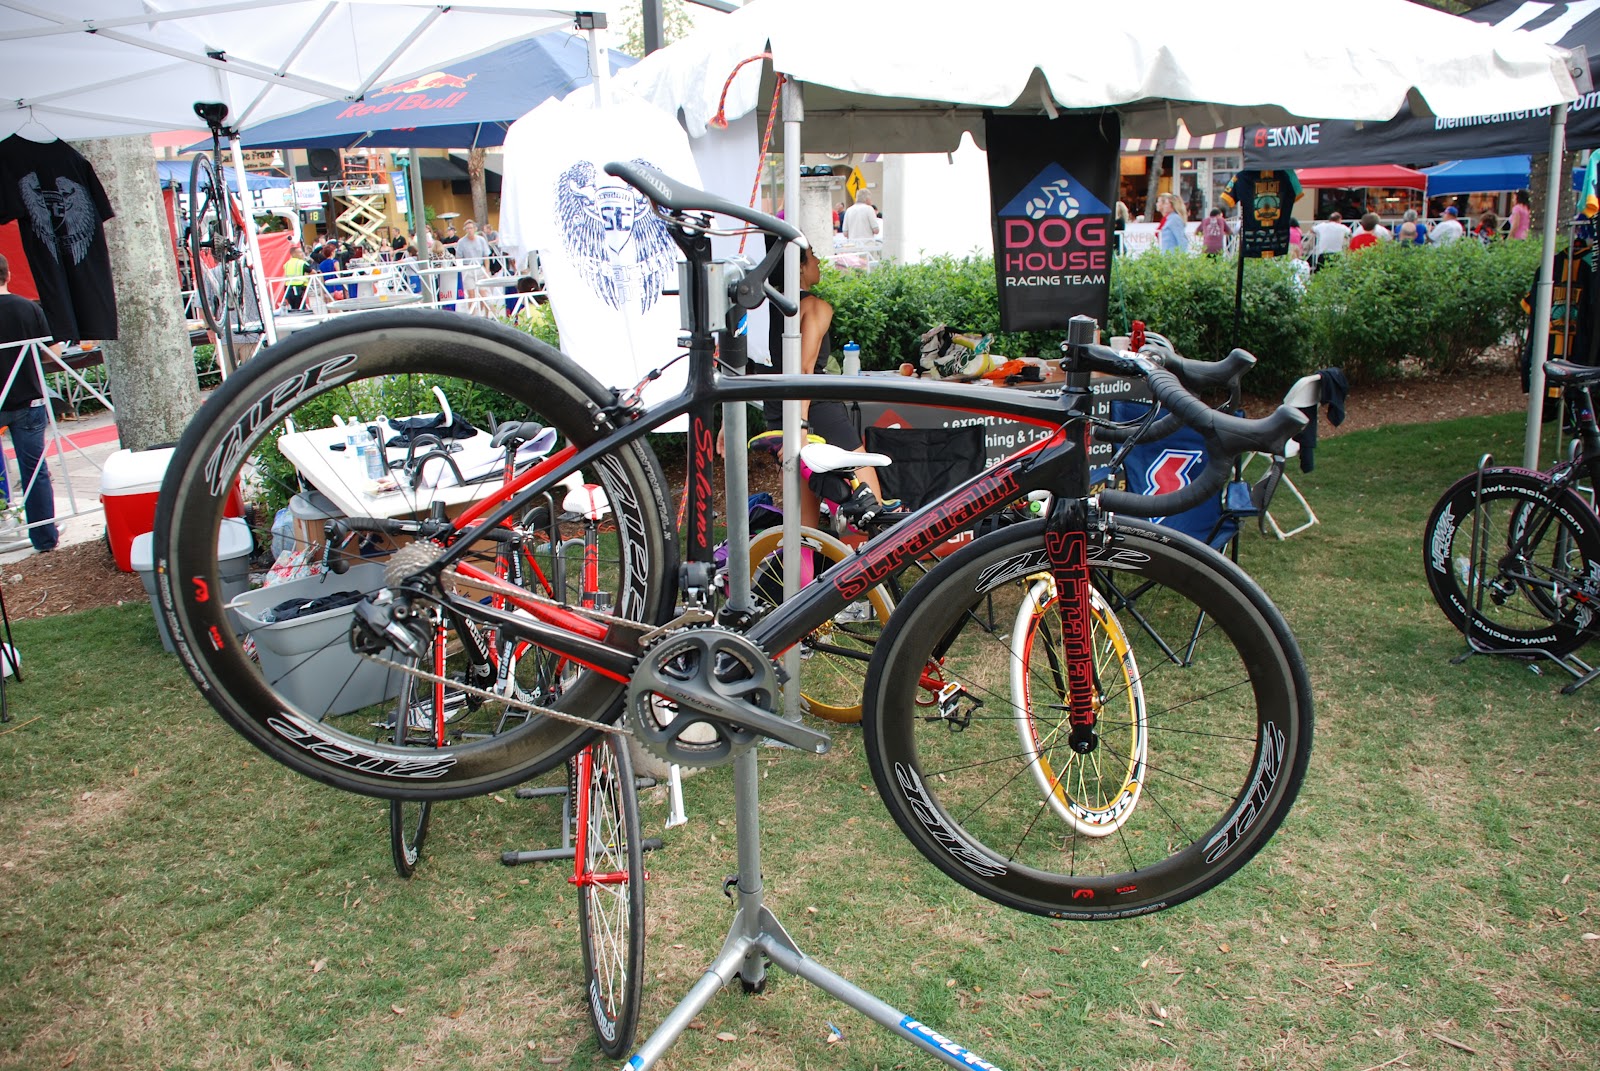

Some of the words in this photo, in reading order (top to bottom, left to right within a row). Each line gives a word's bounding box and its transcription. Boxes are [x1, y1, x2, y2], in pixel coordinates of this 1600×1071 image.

[335, 95, 404, 120] Red
[394, 91, 469, 111] Bull
[1005, 217, 1106, 249] DOG
[1005, 251, 1106, 272] HOUSE
[1005, 275, 1061, 287] RACING
[1064, 275, 1106, 285] TEAM
[1093, 380, 1131, 395] studio
[204, 353, 359, 497] ZIPP
[984, 433, 1015, 448] hing
[694, 417, 713, 548] Salerno
[266, 717, 458, 779] ZIPP
[1206, 721, 1285, 864] ZIPP
[895, 761, 1007, 877] ZIPP
[905, 1020, 964, 1056] Tool
